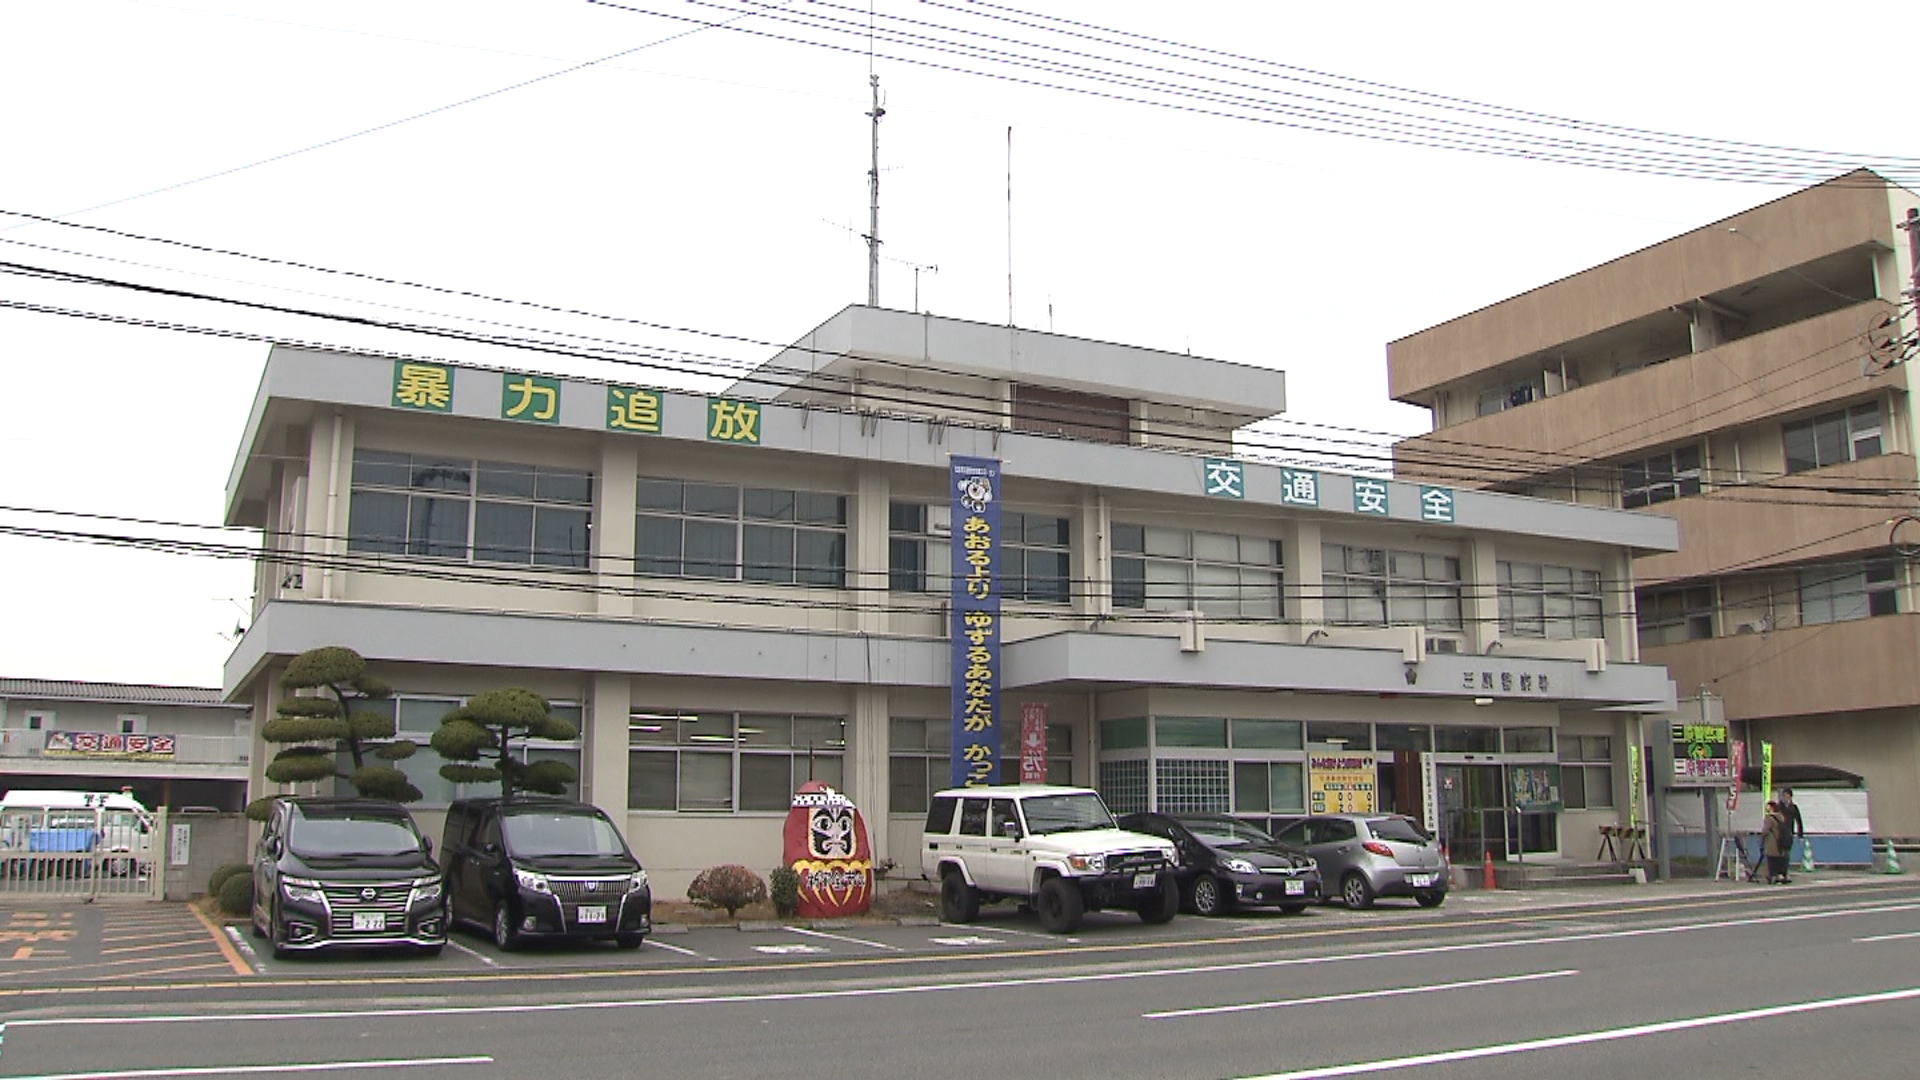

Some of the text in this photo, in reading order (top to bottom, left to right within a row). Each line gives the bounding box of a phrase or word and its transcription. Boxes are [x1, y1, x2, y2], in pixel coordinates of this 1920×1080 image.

[395, 365, 759, 443] 暴力追放
[1206, 461, 1453, 522] 交通安全
[963, 515, 992, 600] あおるより
[963, 610, 993, 733] ゆずるあなたが
[75, 733, 174, 752] 交通安全
